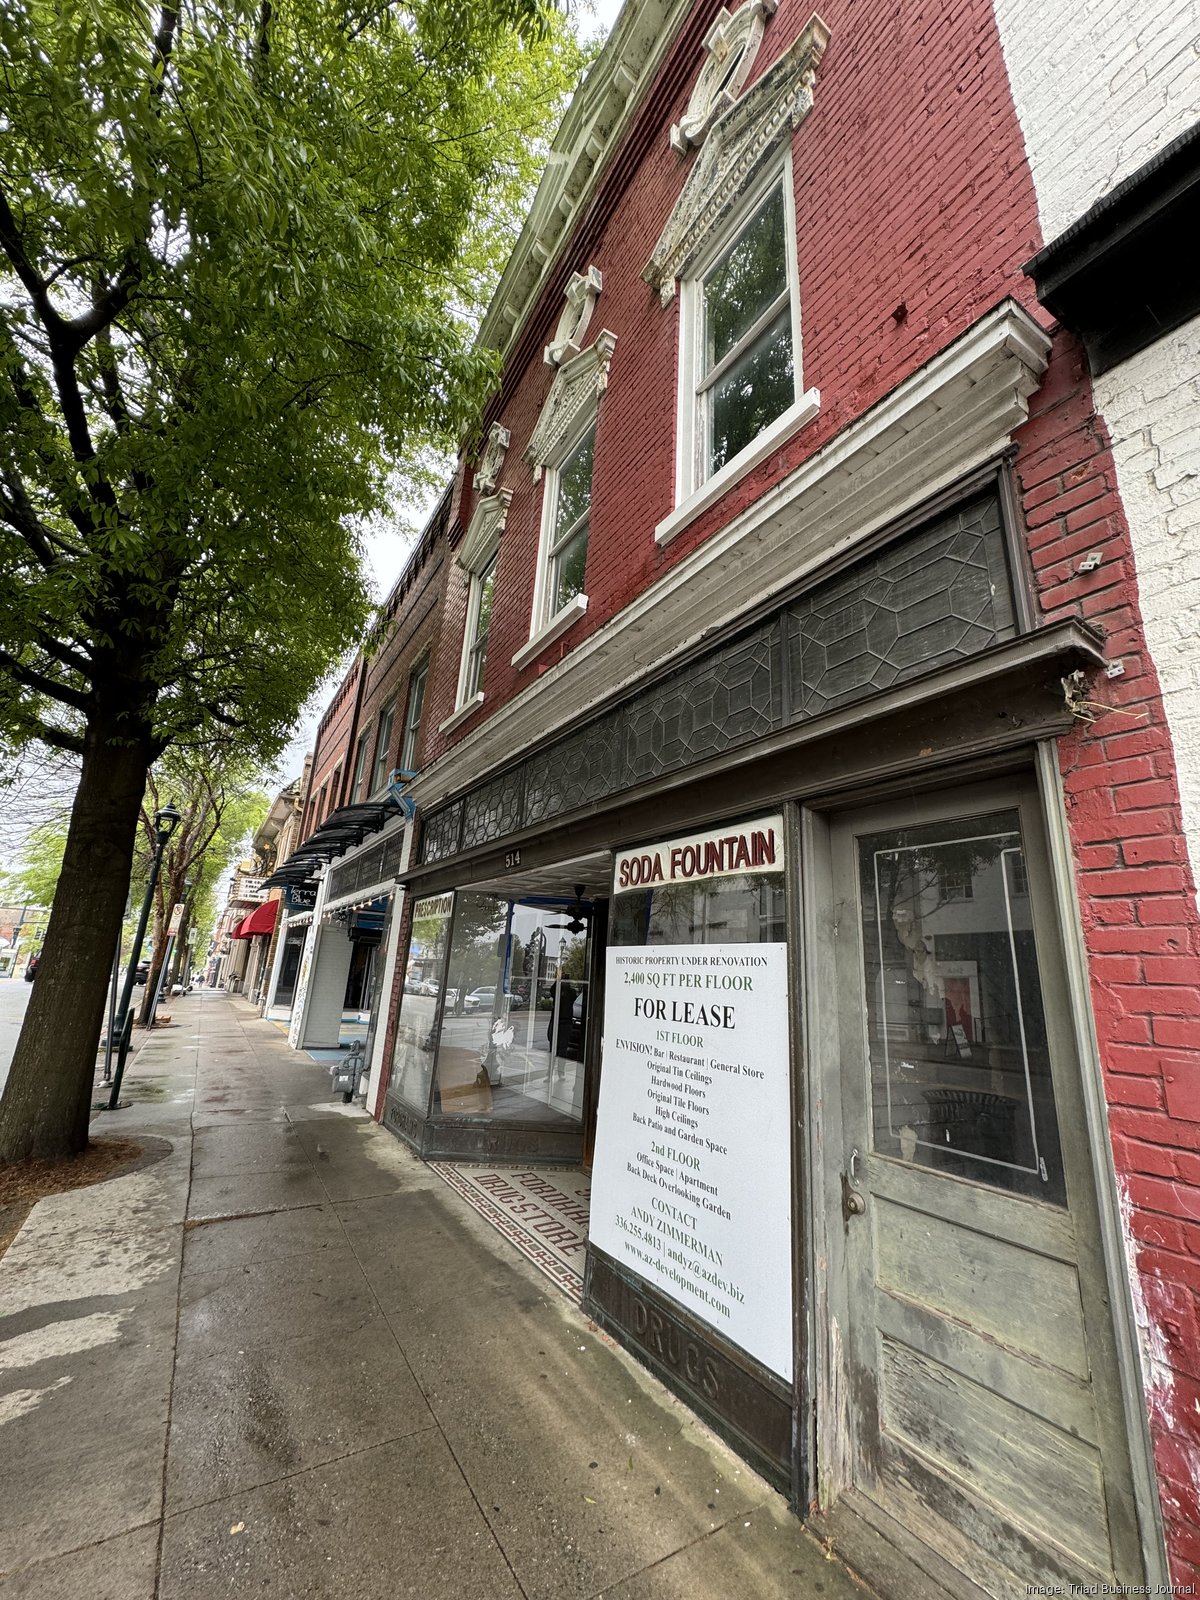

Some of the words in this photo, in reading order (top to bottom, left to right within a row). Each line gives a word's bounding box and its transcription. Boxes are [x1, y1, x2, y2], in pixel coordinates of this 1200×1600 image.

[506, 850, 520, 868] 514
[619, 853, 664, 887] SODA
[670, 828, 775, 880] FOUNTAIN
[288, 884, 316, 896] Terra
[292, 894, 311, 904] Blue
[415, 896, 452, 917] PRESCRIPTION
[616, 956, 644, 965] HISTORIC
[645, 957, 680, 966] PROPERTY
[681, 957, 708, 966] UNDER
[710, 957, 768, 967] RENOVATION
[624, 972, 644, 985] 2,400
[647, 972, 660, 988] SQ
[663, 974, 676, 987] FT
[679, 974, 702, 988] PER
[706, 975, 753, 991] FLOOR
[634, 998, 666, 1020] FOR
[672, 1001, 736, 1029] LEASE
[656, 1030, 670, 1042] 1ST
[672, 1032, 703, 1048] FLOOR
[616, 1039, 652, 1056] ENVISION!
[654, 1048, 664, 1058] Bar
[669, 1051, 704, 1066] Restaurant
[710, 1059, 740, 1074] General
[742, 1066, 764, 1080] Store
[647, 1061, 671, 1075] Original
[673, 1066, 683, 1076] Tin
[685, 1069, 712, 1086] Ceilings
[651, 1076, 683, 1092] Hardwood
[684, 1084, 706, 1098] Floors
[647, 1089, 671, 1104] Original
[674, 1096, 686, 1108] Tile
[688, 1101, 710, 1116] Floors
[655, 1106, 670, 1120] High
[671, 1111, 698, 1129] Ceilings
[632, 1112, 646, 1125] Back
[648, 1119, 663, 1132] Patio
[664, 1126, 676, 1137] and
[678, 1129, 704, 1147] Garden
[706, 1138, 728, 1155] Space
[651, 1141, 665, 1156] 2nd
[667, 1147, 701, 1171] FLOOR
[637, 1152, 654, 1168] Office
[656, 1160, 674, 1177] Space
[679, 1172, 718, 1196] Apartment
[511, 1172, 590, 1228] FORDHA
[627, 1162, 641, 1177] Back
[642, 1169, 657, 1185] Deck
[659, 1177, 700, 1208] Overlooking
[702, 1197, 731, 1220] Garden
[651, 1197, 698, 1230] CONTACT
[631, 1206, 655, 1227] ANDY
[657, 1218, 723, 1267] ZIMMERMAN
[615, 1215, 662, 1251] 336.255.4813
[668, 1248, 745, 1305] andyz@azdev.biz
[624, 1241, 731, 1318] www.az-development.com
[634, 1298, 719, 1399] DRUGS
